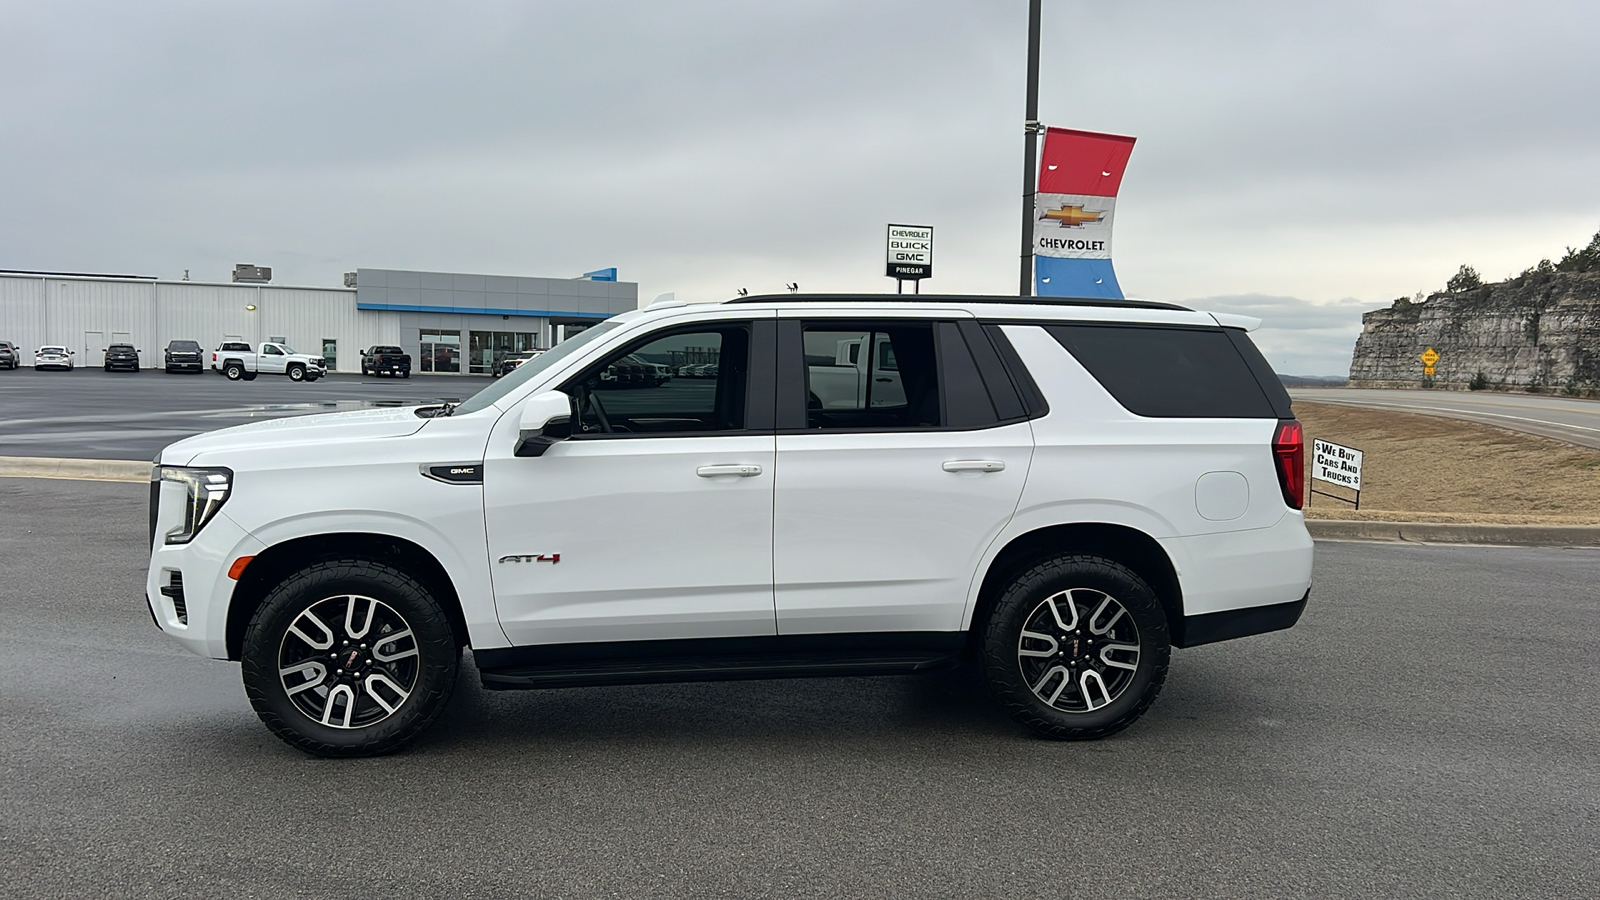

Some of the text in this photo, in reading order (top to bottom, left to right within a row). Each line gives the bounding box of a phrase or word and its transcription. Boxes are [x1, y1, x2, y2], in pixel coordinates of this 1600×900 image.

[891, 230, 930, 239] CHEVROLET
[891, 241, 929, 250] BUICK
[896, 252, 924, 261] GMC
[895, 266, 924, 274] PINEGAR
[498, 553, 561, 565] AT4
